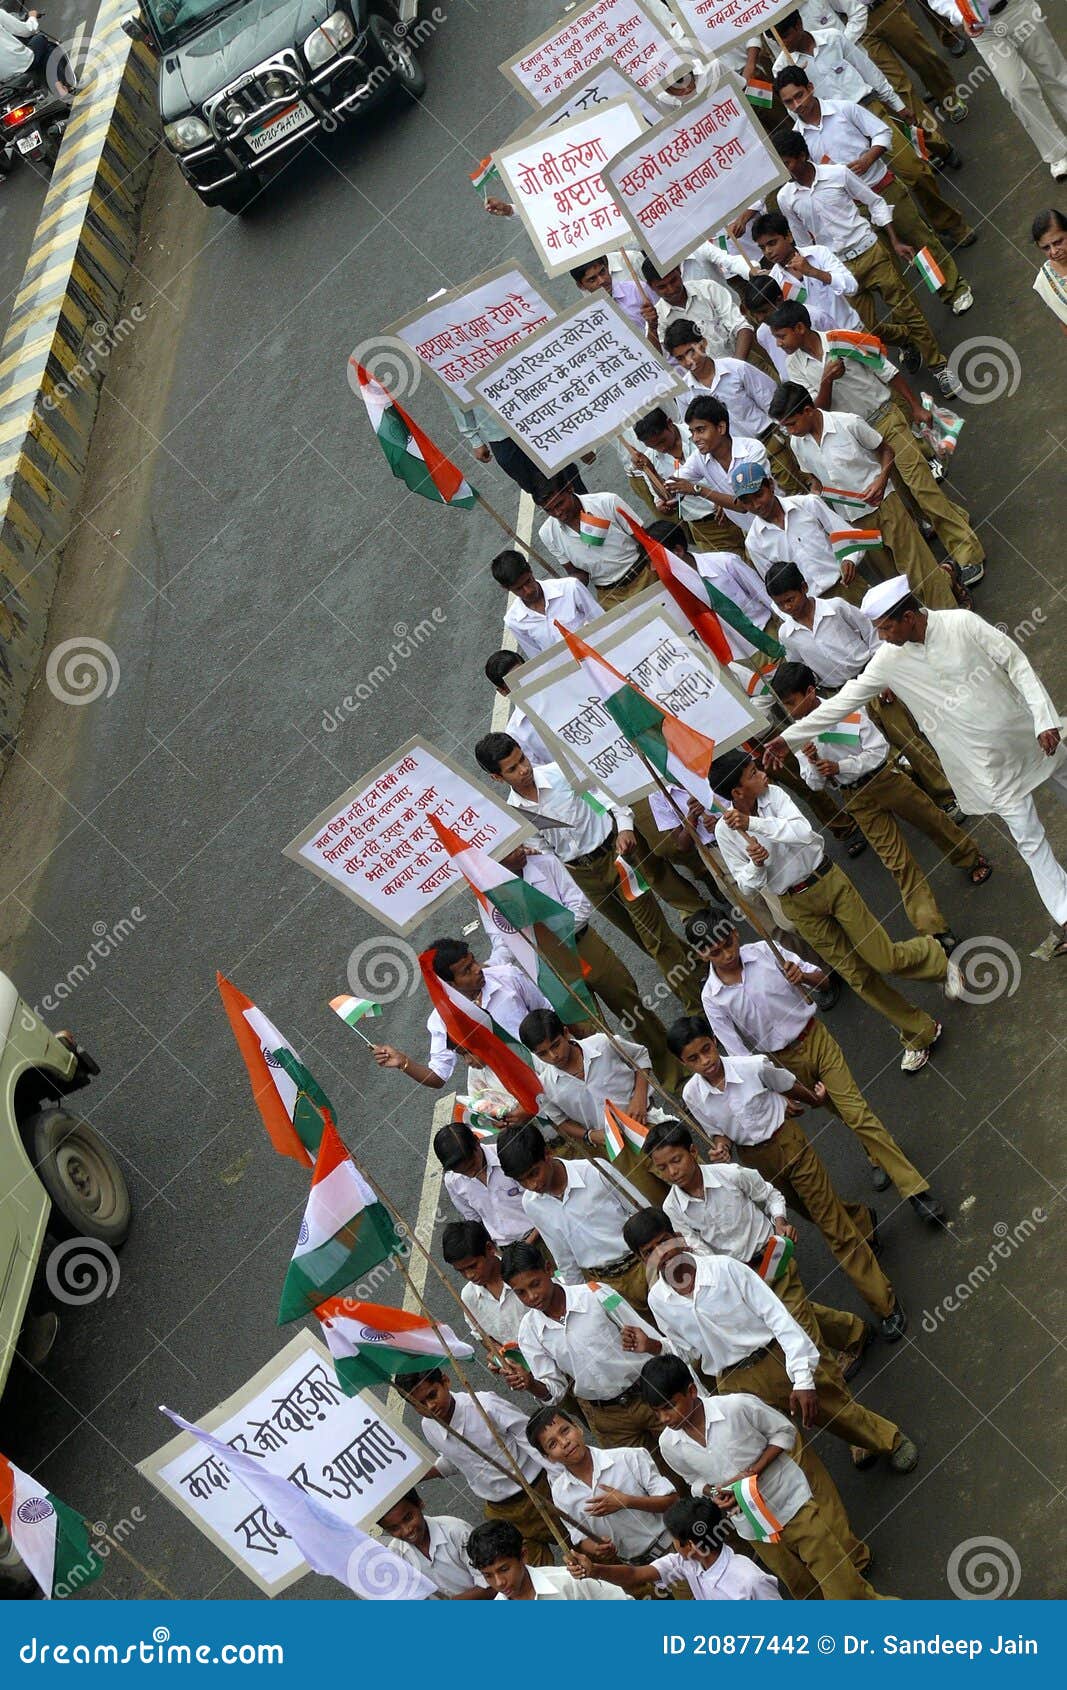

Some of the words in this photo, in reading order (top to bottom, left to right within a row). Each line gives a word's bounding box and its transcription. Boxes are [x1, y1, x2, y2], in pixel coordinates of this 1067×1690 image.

[518, 163, 539, 194] जो
[538, 153, 564, 185] भी
[560, 138, 608, 175] करेगा
[619, 154, 662, 196] सड़कों
[657, 145, 680, 167] पर
[672, 129, 695, 160] हमें
[689, 113, 718, 144] आना
[712, 99, 740, 127] होगा
[637, 193, 669, 228] सबको
[666, 180, 687, 207] हमें
[680, 158, 718, 193] बताना
[712, 137, 745, 169] होगा
[546, 226, 562, 248] वो
[562, 217, 589, 247] देश
[590, 207, 611, 230] का
[416, 331, 460, 362] भ्रष्टाचार
[446, 324, 469, 342] जो
[463, 315, 495, 337] आम
[451, 354, 477, 373] से
[468, 345, 494, 369] उसे
[483, 379, 509, 400] भ्रष्ट
[506, 366, 531, 385] और
[522, 340, 565, 373] रिश्वत
[591, 308, 609, 326] को
[499, 398, 521, 420] हम
[514, 372, 558, 404] मिलकर
[555, 364, 570, 380] के
[515, 397, 564, 435] भ्रष्टाचार
[559, 376, 591, 403] कहीं
[584, 369, 600, 385] न
[596, 354, 625, 377] होने
[530, 427, 562, 451] ऐसा
[589, 383, 625, 412] समाज
[558, 717, 593, 745] बहुत
[579, 704, 606, 727] सो
[632, 657, 662, 687] जग
[363, 789, 382, 808] हम
[401, 807, 417, 823] को
[414, 786, 439, 811] अपने
[322, 835, 355, 864] कितना
[350, 825, 365, 840] ही
[361, 815, 380, 833] हम
[365, 858, 388, 882] भले
[409, 825, 430, 842] मर
[381, 863, 420, 896] कदाचार
[414, 851, 432, 868] को
[459, 806, 480, 827] हम
[417, 860, 458, 894] सदाचार
[247, 1420, 287, 1454] को
[272, 1364, 348, 1431] छोड़कर
[323, 1419, 406, 1499] अपनाएं
